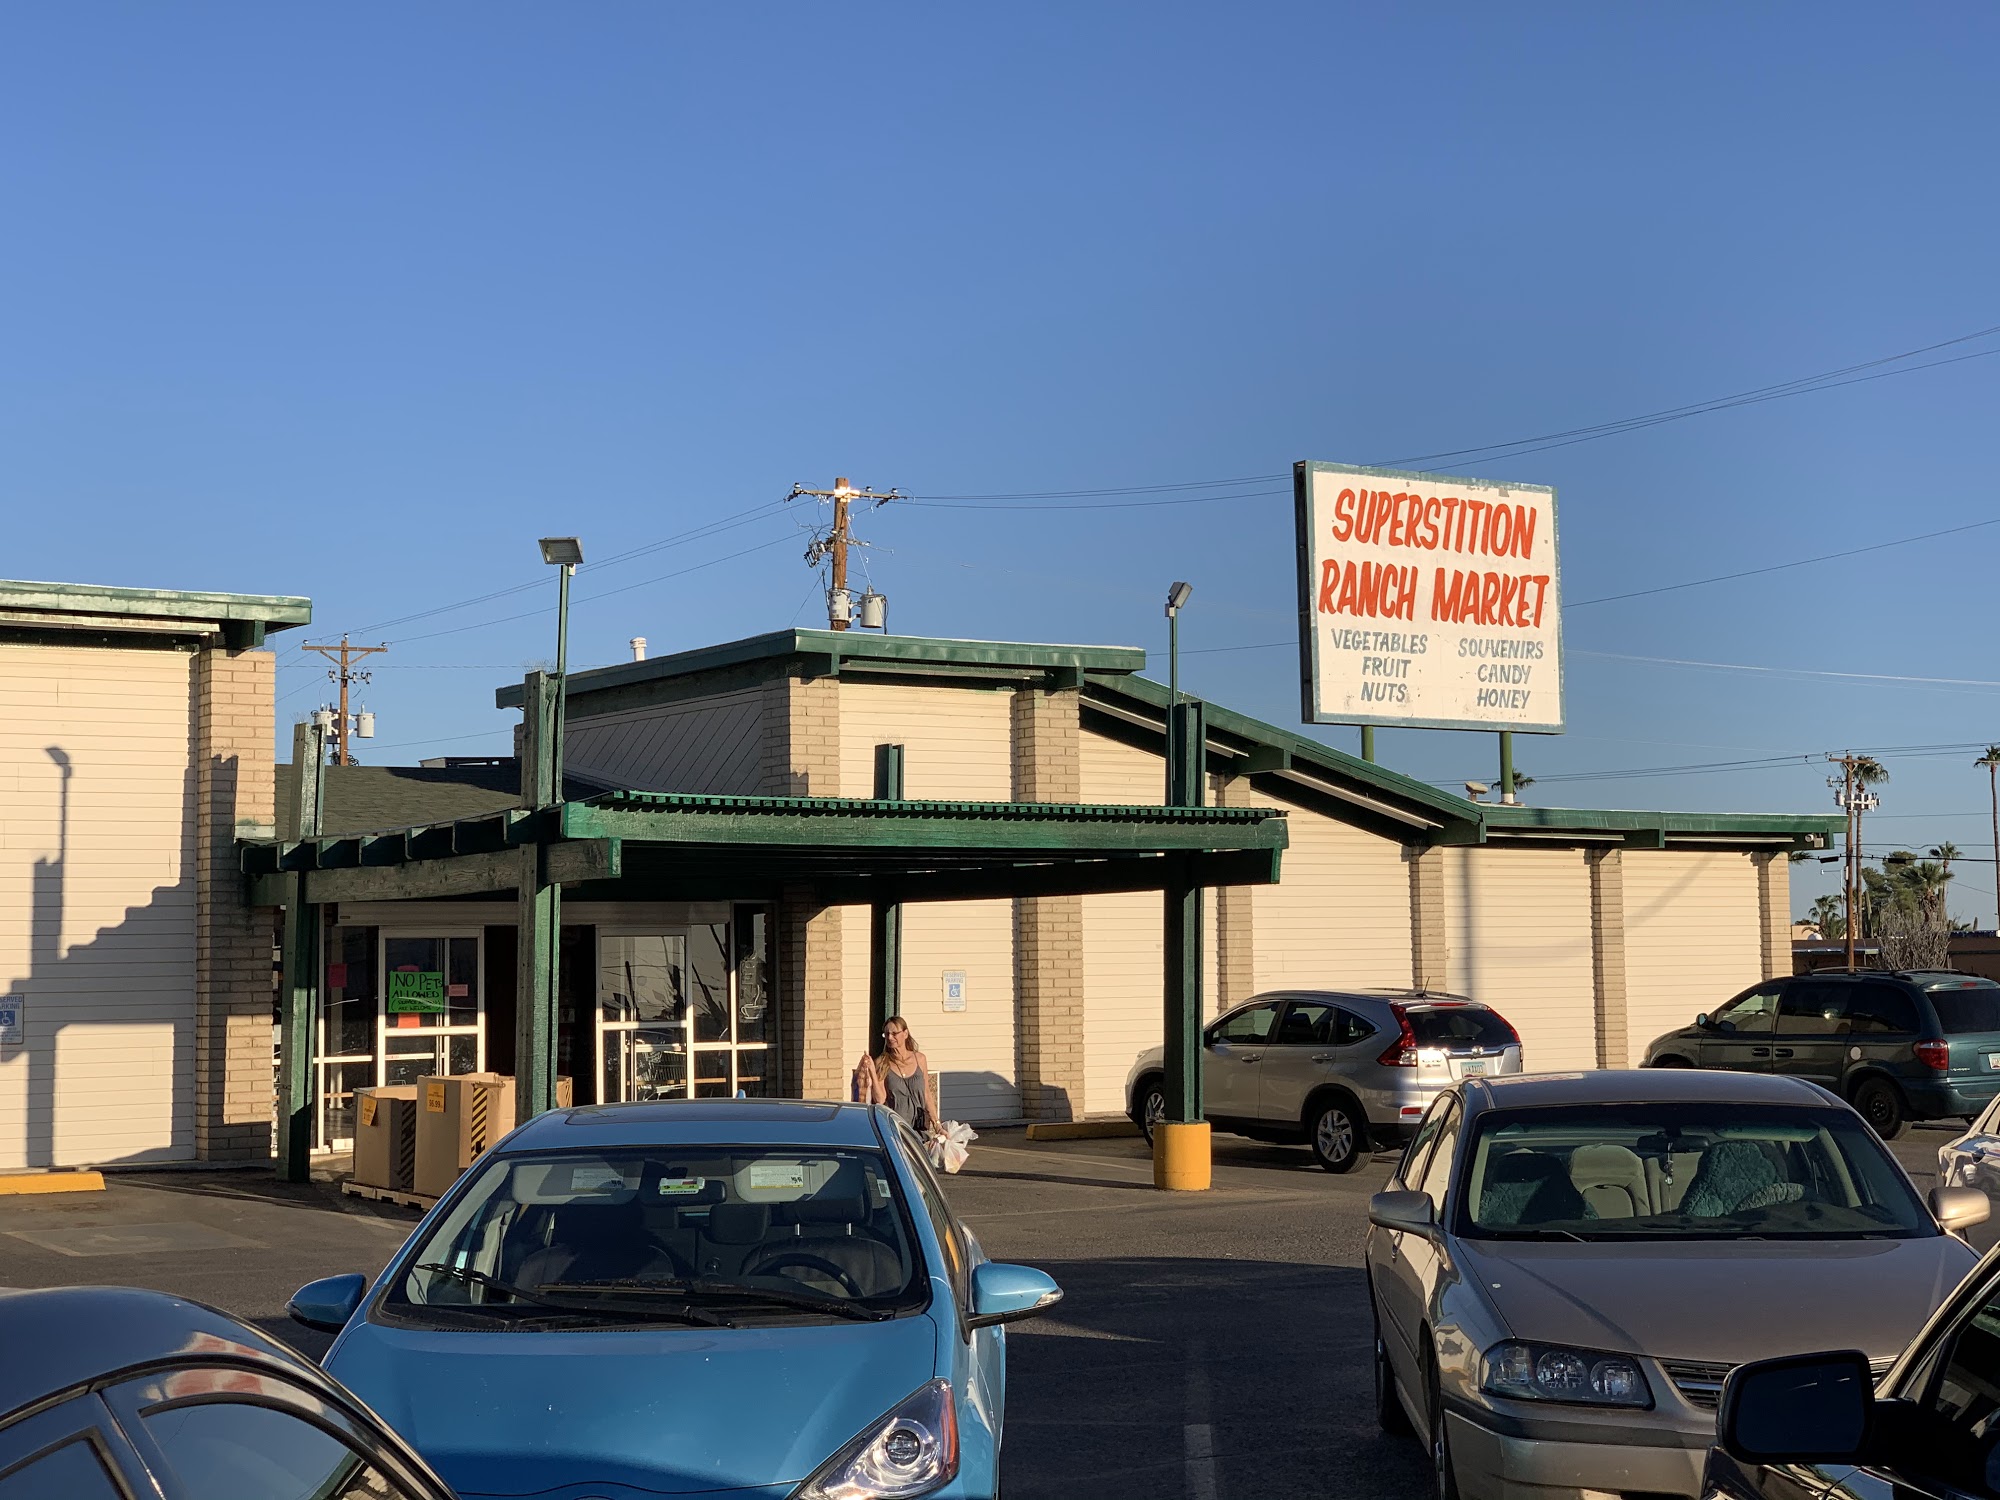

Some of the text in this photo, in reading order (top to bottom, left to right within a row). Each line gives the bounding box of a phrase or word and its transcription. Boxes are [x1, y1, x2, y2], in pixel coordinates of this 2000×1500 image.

[1332, 488, 1536, 560] SUPERSTITION
[1318, 559, 1550, 629] RANCH MARKET
[1331, 628, 1428, 654] VEGETABLES
[1458, 637, 1544, 659] SOUVENIRS
[1362, 656, 1411, 678] FRUIT
[1477, 664, 1532, 685] CANDY
[1360, 681, 1407, 702] NUTS
[1477, 688, 1531, 709] HONEY
[395, 973, 415, 987] NO
[419, 973, 443, 990] PETS
[391, 990, 440, 998] ALLOWED
